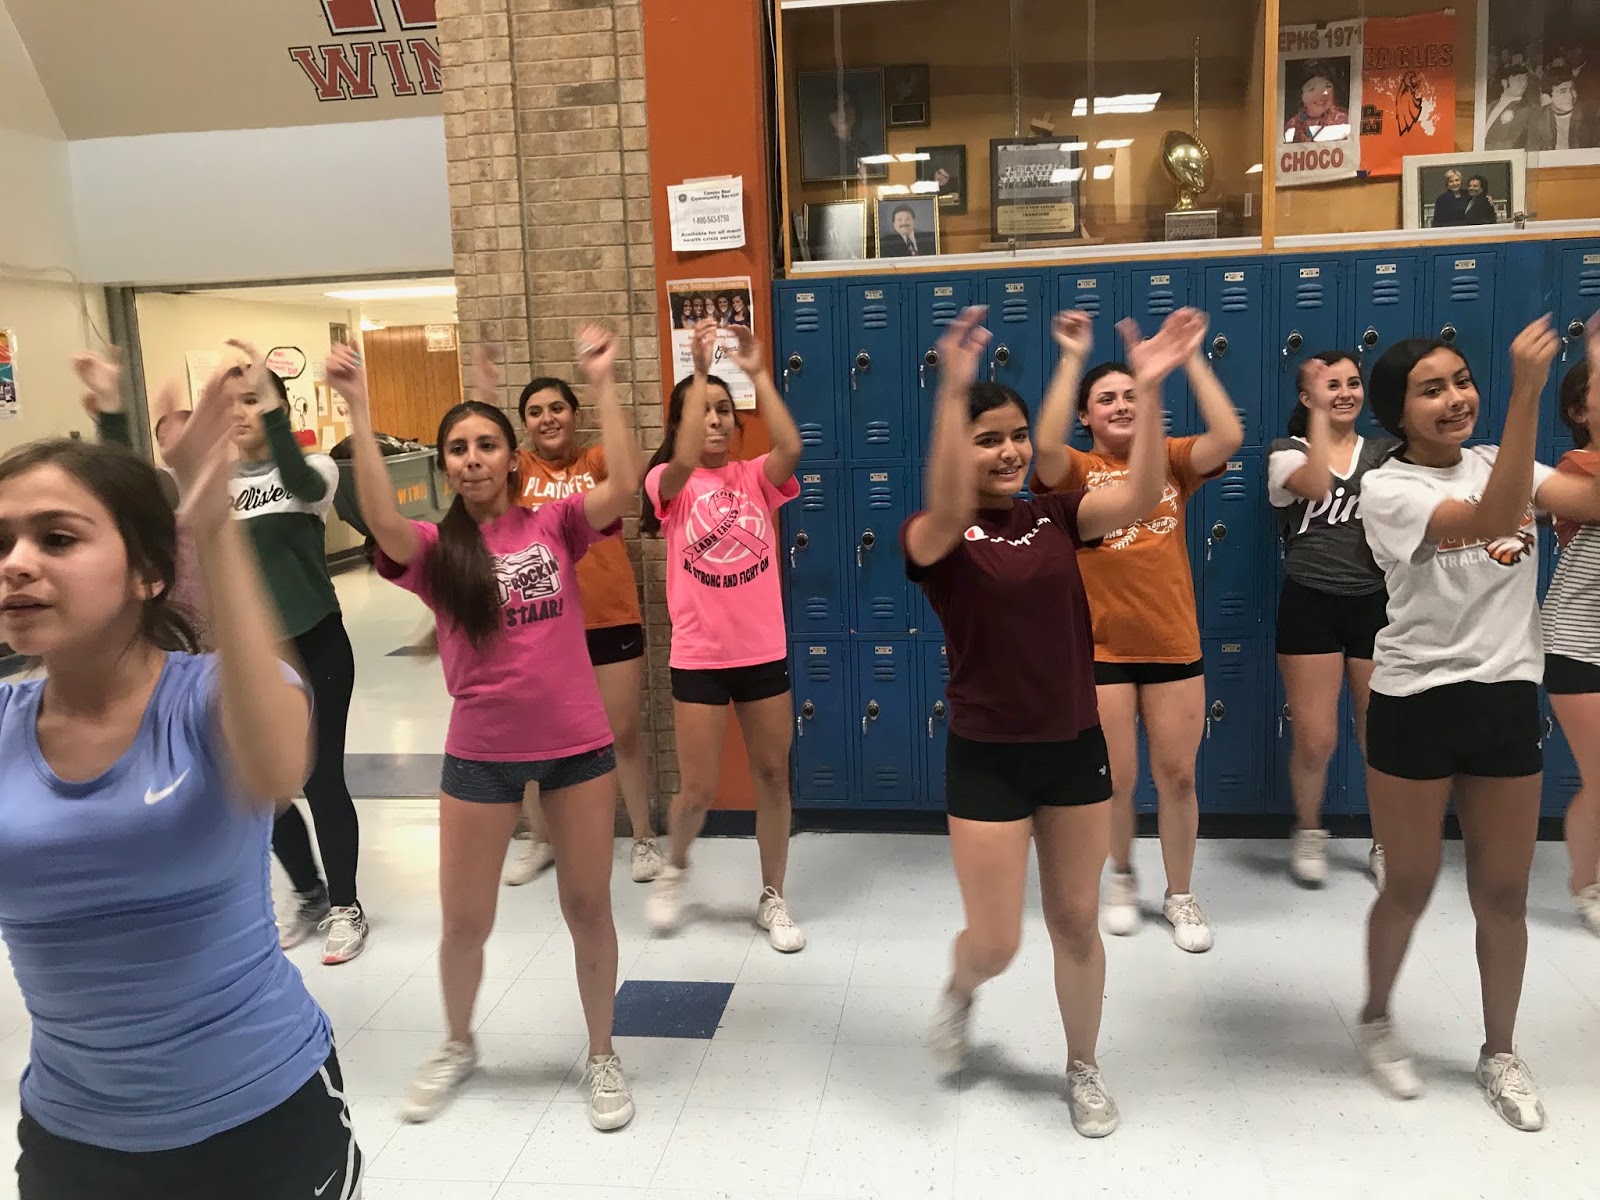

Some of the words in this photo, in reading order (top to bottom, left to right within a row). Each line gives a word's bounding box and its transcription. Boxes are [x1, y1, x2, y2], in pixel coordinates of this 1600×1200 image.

[1278, 30, 1320, 52] EPHS
[1325, 25, 1362, 48] 1971
[1363, 43, 1453, 69] EAGLES
[1280, 148, 1344, 172] CHOCO
[689, 282, 714, 290] School
[714, 280, 745, 288] Students
[523, 471, 596, 500] PLAYOFFS
[717, 509, 739, 535] EAGLES
[694, 534, 718, 553] LADY
[684, 558, 692, 574] BE
[692, 567, 720, 588] STRONG
[723, 574, 738, 588] AND
[739, 564, 758, 585] FIGHT
[760, 556, 769, 572] ON
[1438, 550, 1488, 569] TRACK
[506, 597, 564, 628] STAAR!
